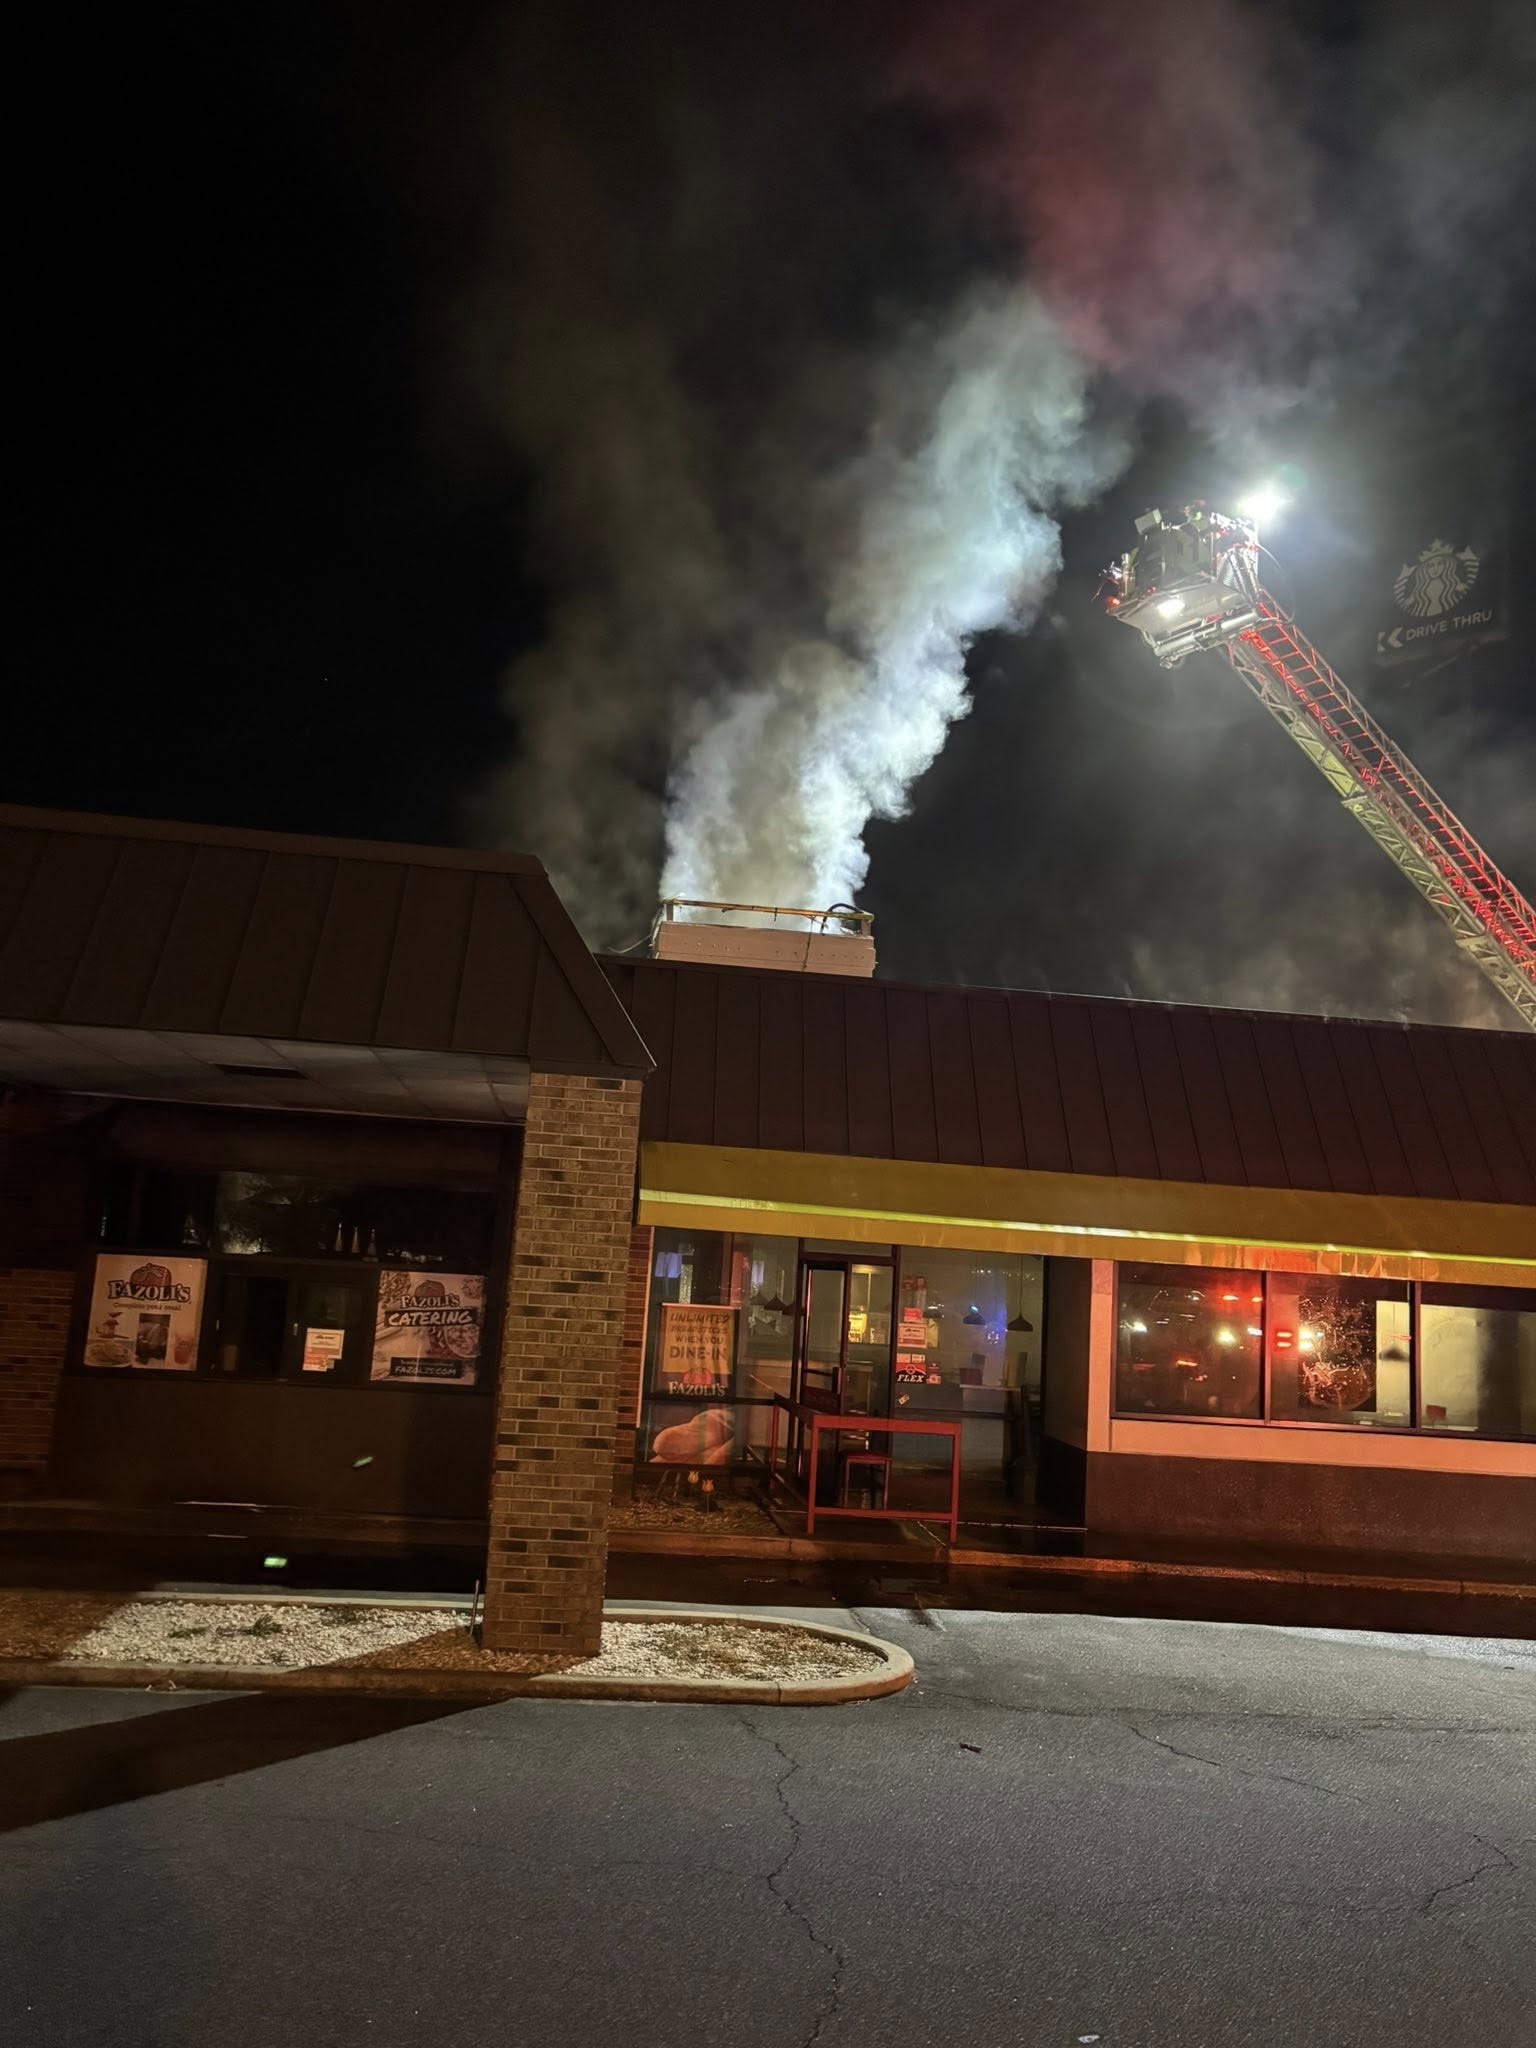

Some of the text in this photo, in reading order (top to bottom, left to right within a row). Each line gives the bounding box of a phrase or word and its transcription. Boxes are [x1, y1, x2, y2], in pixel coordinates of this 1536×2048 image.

[1406, 610, 1492, 641] DRIVE THRU
[108, 1280, 191, 1303] FAZOLI'S
[400, 1294, 460, 1309] FAZOLI'S
[388, 1310, 472, 1326] CATERING
[670, 1312, 730, 1324] UNLIMITED
[675, 1335, 723, 1345] WHEN YOU
[669, 1345, 728, 1361] DINE-IN
[897, 1374, 924, 1382] FLEX
[668, 1381, 726, 1396] FAZOLI'S
